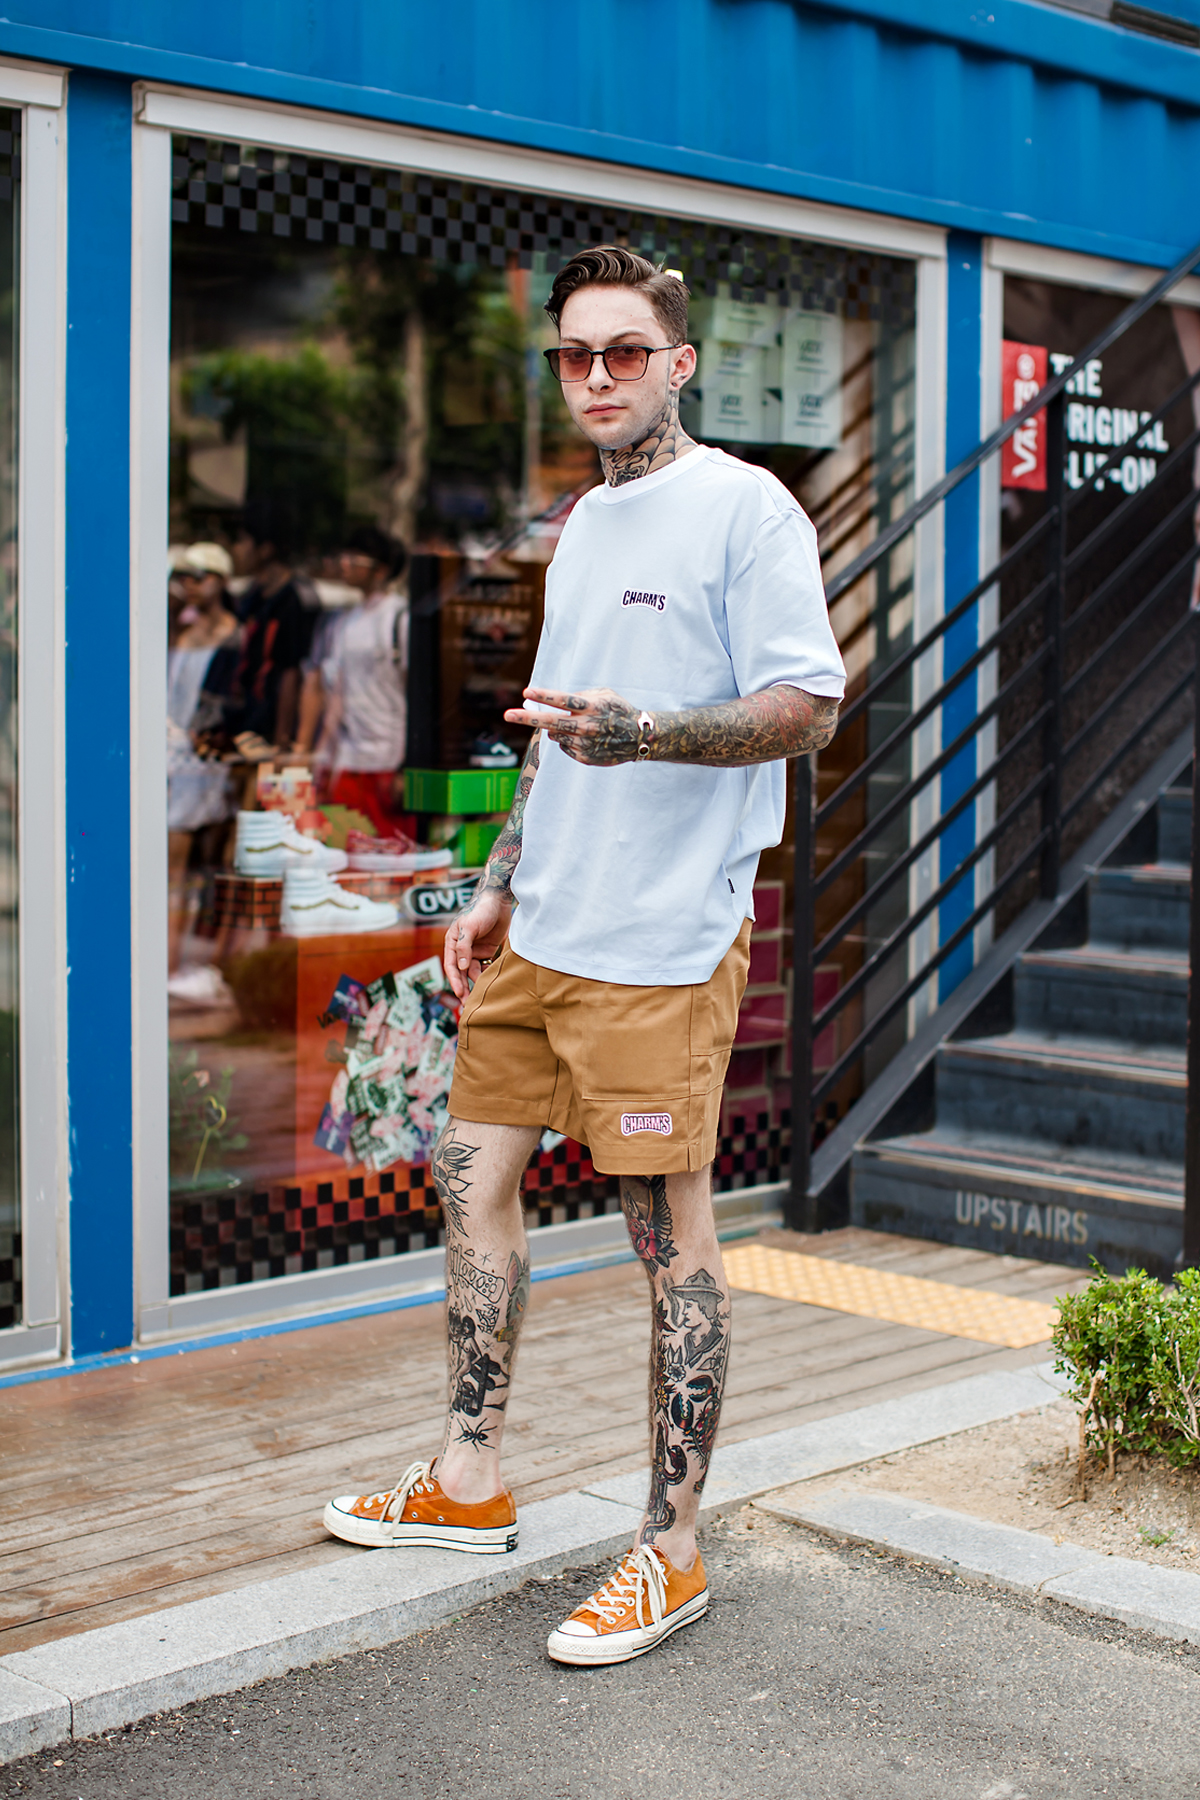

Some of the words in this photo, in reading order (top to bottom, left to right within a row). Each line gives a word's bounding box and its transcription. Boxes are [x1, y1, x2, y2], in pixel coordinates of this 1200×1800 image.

[1064, 402, 1169, 453] RIGINAL
[1063, 451, 1157, 495] LIP-ON
[622, 590, 666, 611] CHARM'S
[622, 1114, 671, 1134] CHARM'S
[955, 1190, 1089, 1246] UPSTAIRS
